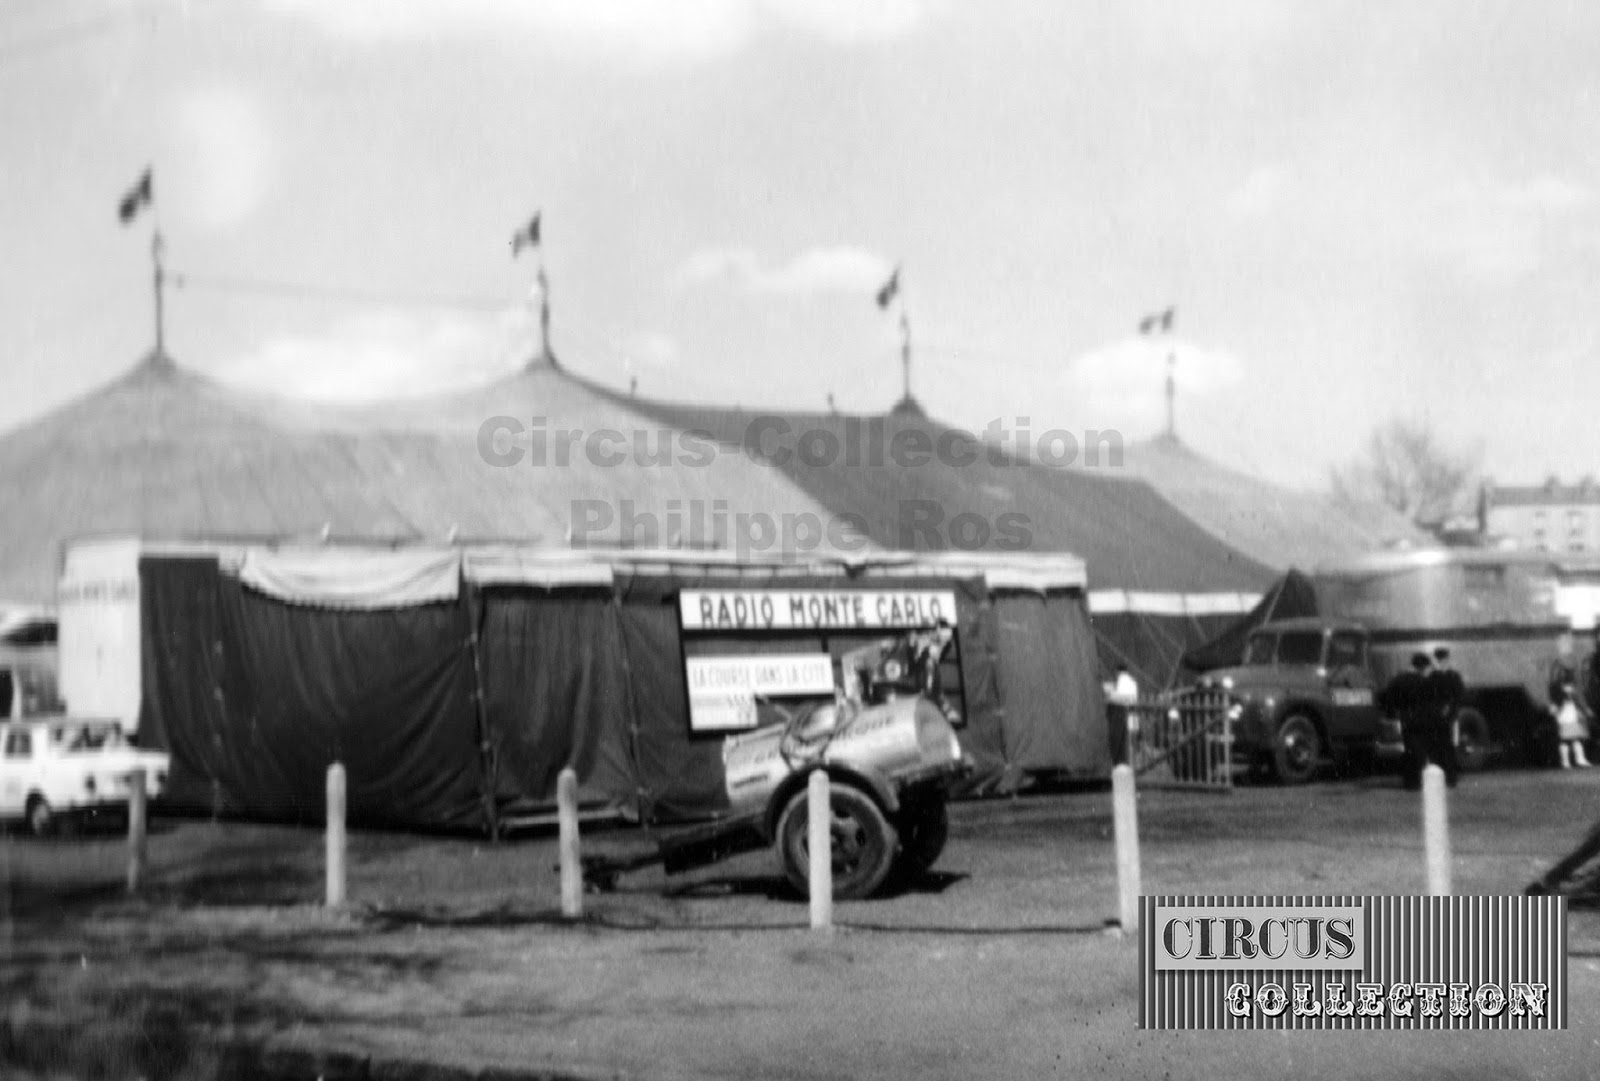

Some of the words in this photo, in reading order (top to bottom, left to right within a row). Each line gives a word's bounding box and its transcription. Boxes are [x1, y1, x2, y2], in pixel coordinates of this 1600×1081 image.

[700, 597, 774, 628] RADIO
[790, 596, 866, 627] MONTE
[876, 595, 943, 627] CARLO
